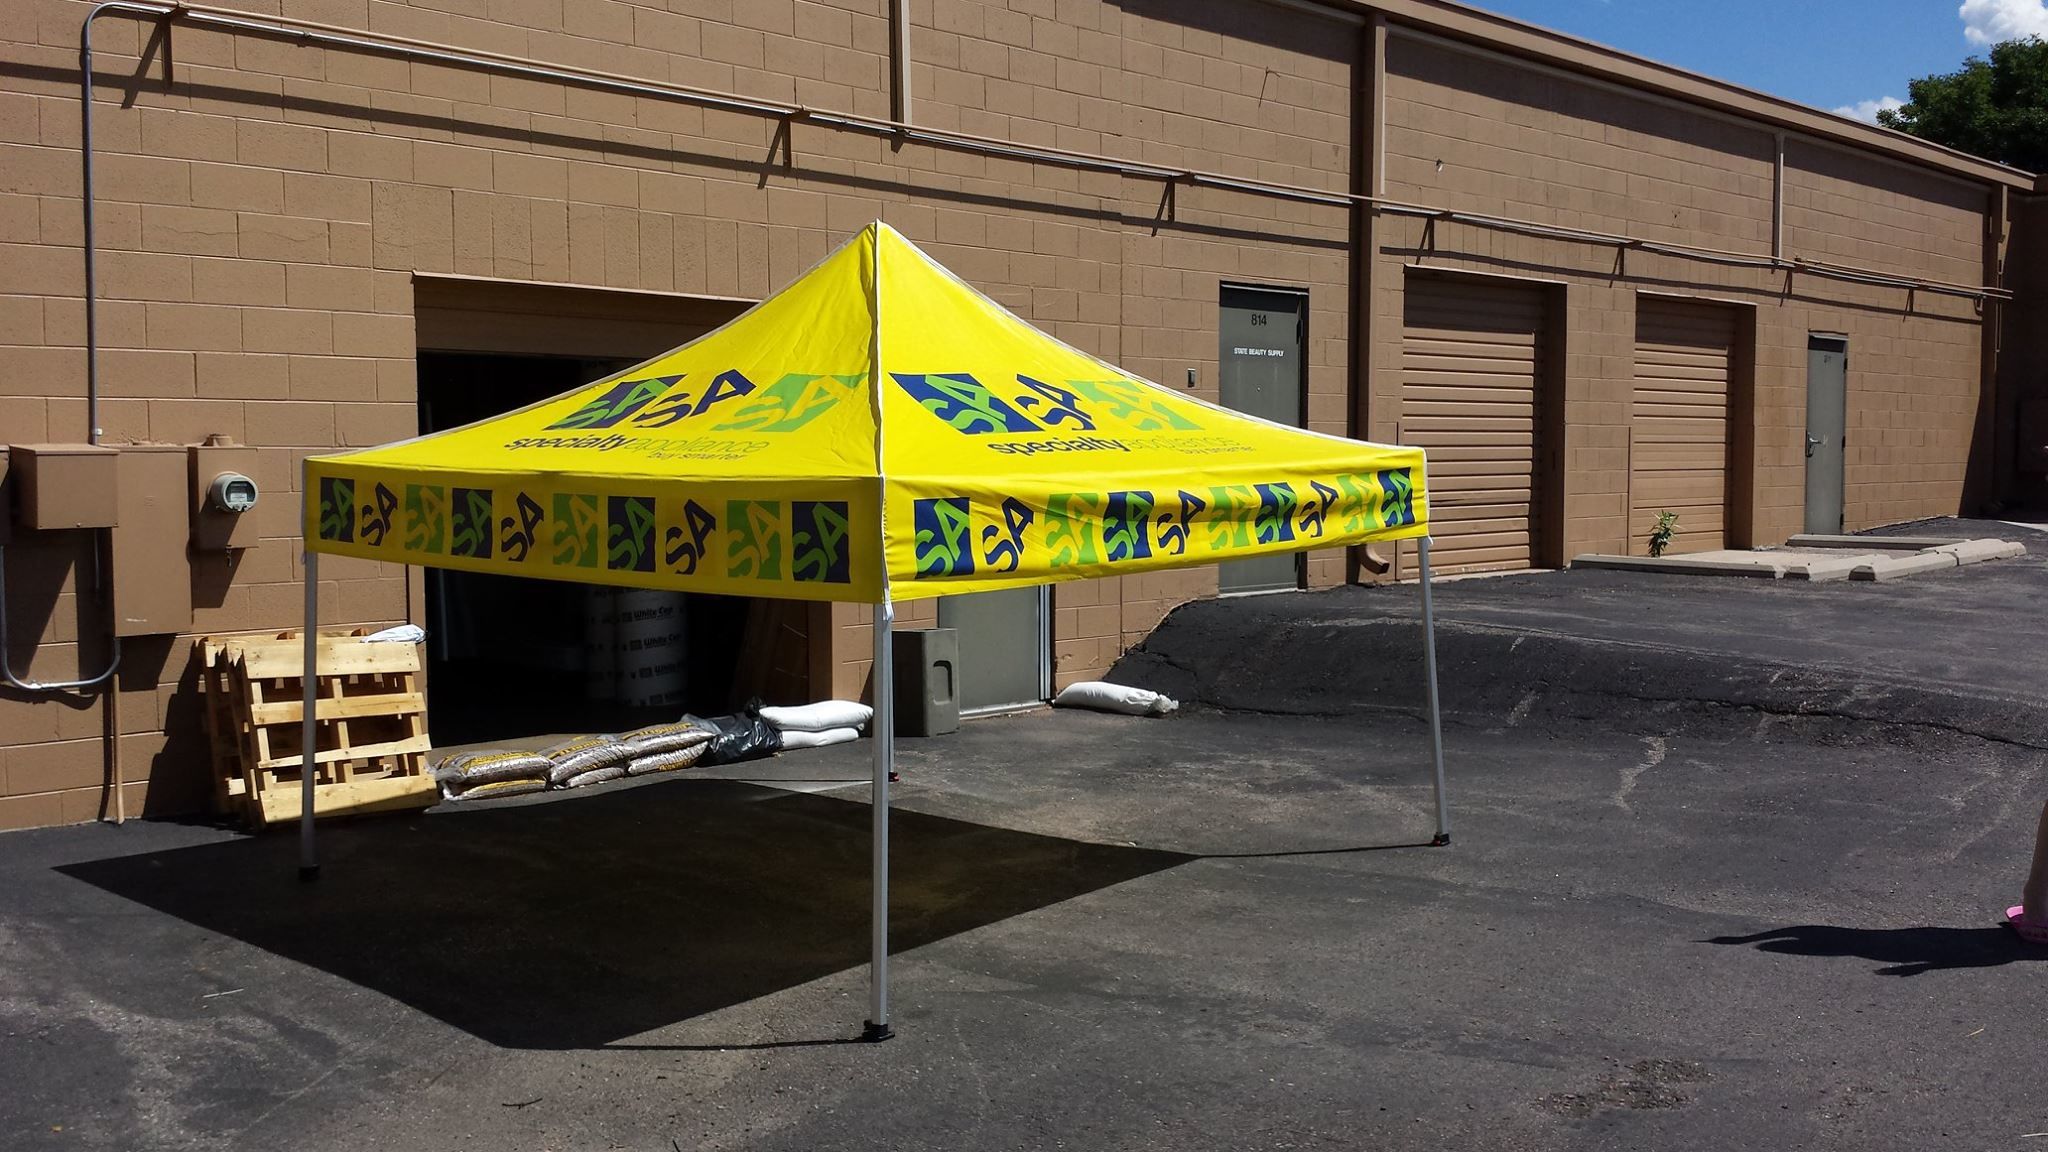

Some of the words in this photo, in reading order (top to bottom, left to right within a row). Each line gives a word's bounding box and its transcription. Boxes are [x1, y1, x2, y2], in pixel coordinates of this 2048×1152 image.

[1251, 314, 1267, 326] 814
[1234, 347, 1248, 355] STATE
[1249, 348, 1267, 356] BEAUTY
[1268, 349, 1284, 357] SUPPLY
